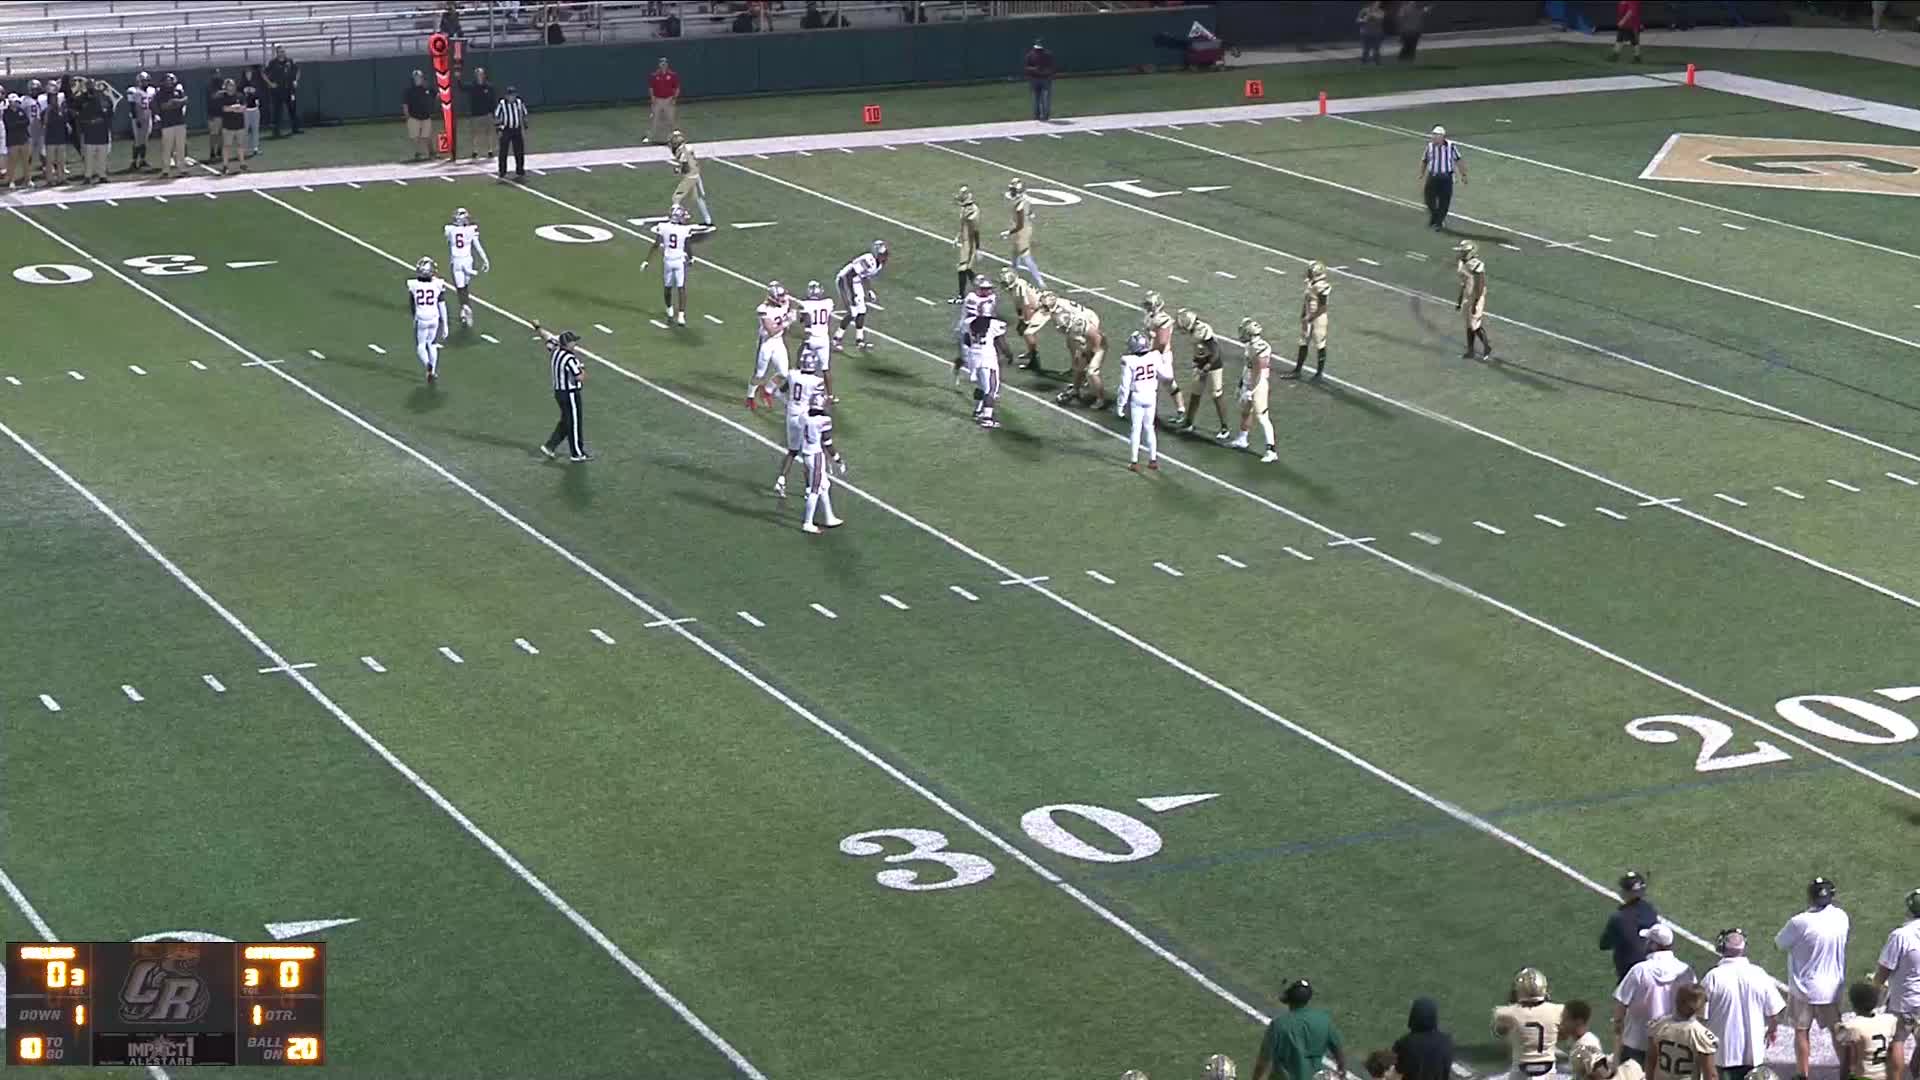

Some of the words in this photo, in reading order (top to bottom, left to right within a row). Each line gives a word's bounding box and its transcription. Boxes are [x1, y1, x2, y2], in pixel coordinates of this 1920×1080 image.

[455, 233, 465, 249] 6
[668, 233, 678, 250] 9
[415, 289, 435, 306] 22
[811, 308, 829, 325] 10
[1134, 364, 1154, 381] 25
[1525, 1021, 1545, 1054] 7
